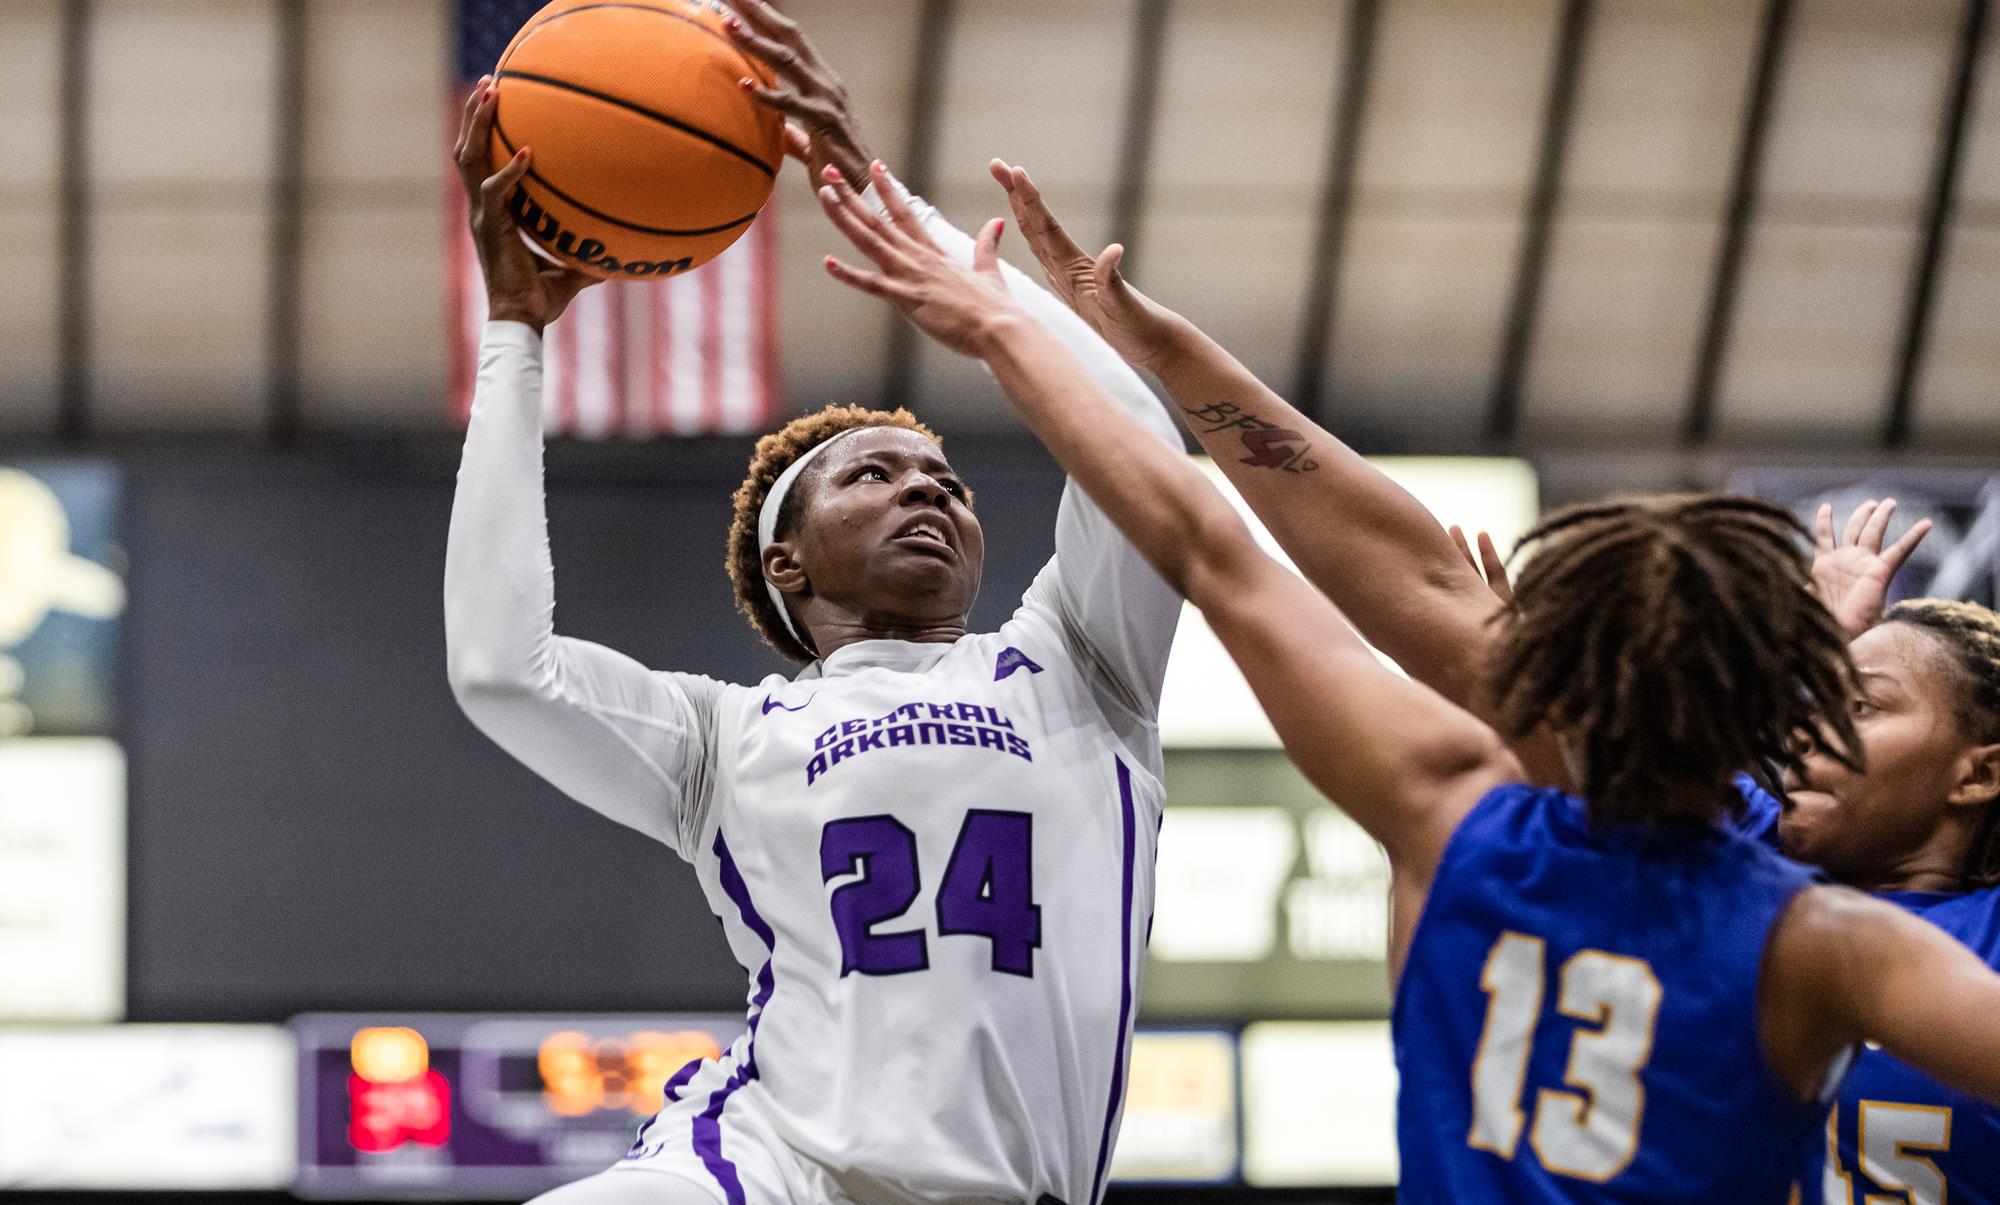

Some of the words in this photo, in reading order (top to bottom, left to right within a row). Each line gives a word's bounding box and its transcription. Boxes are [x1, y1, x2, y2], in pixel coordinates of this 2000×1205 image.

[511, 184, 694, 276] Wilson
[805, 722, 1033, 787] ARKANSAS
[813, 702, 1014, 751] CENTRAL
[819, 808, 1042, 979] 24
[1467, 930, 1664, 1184] 13
